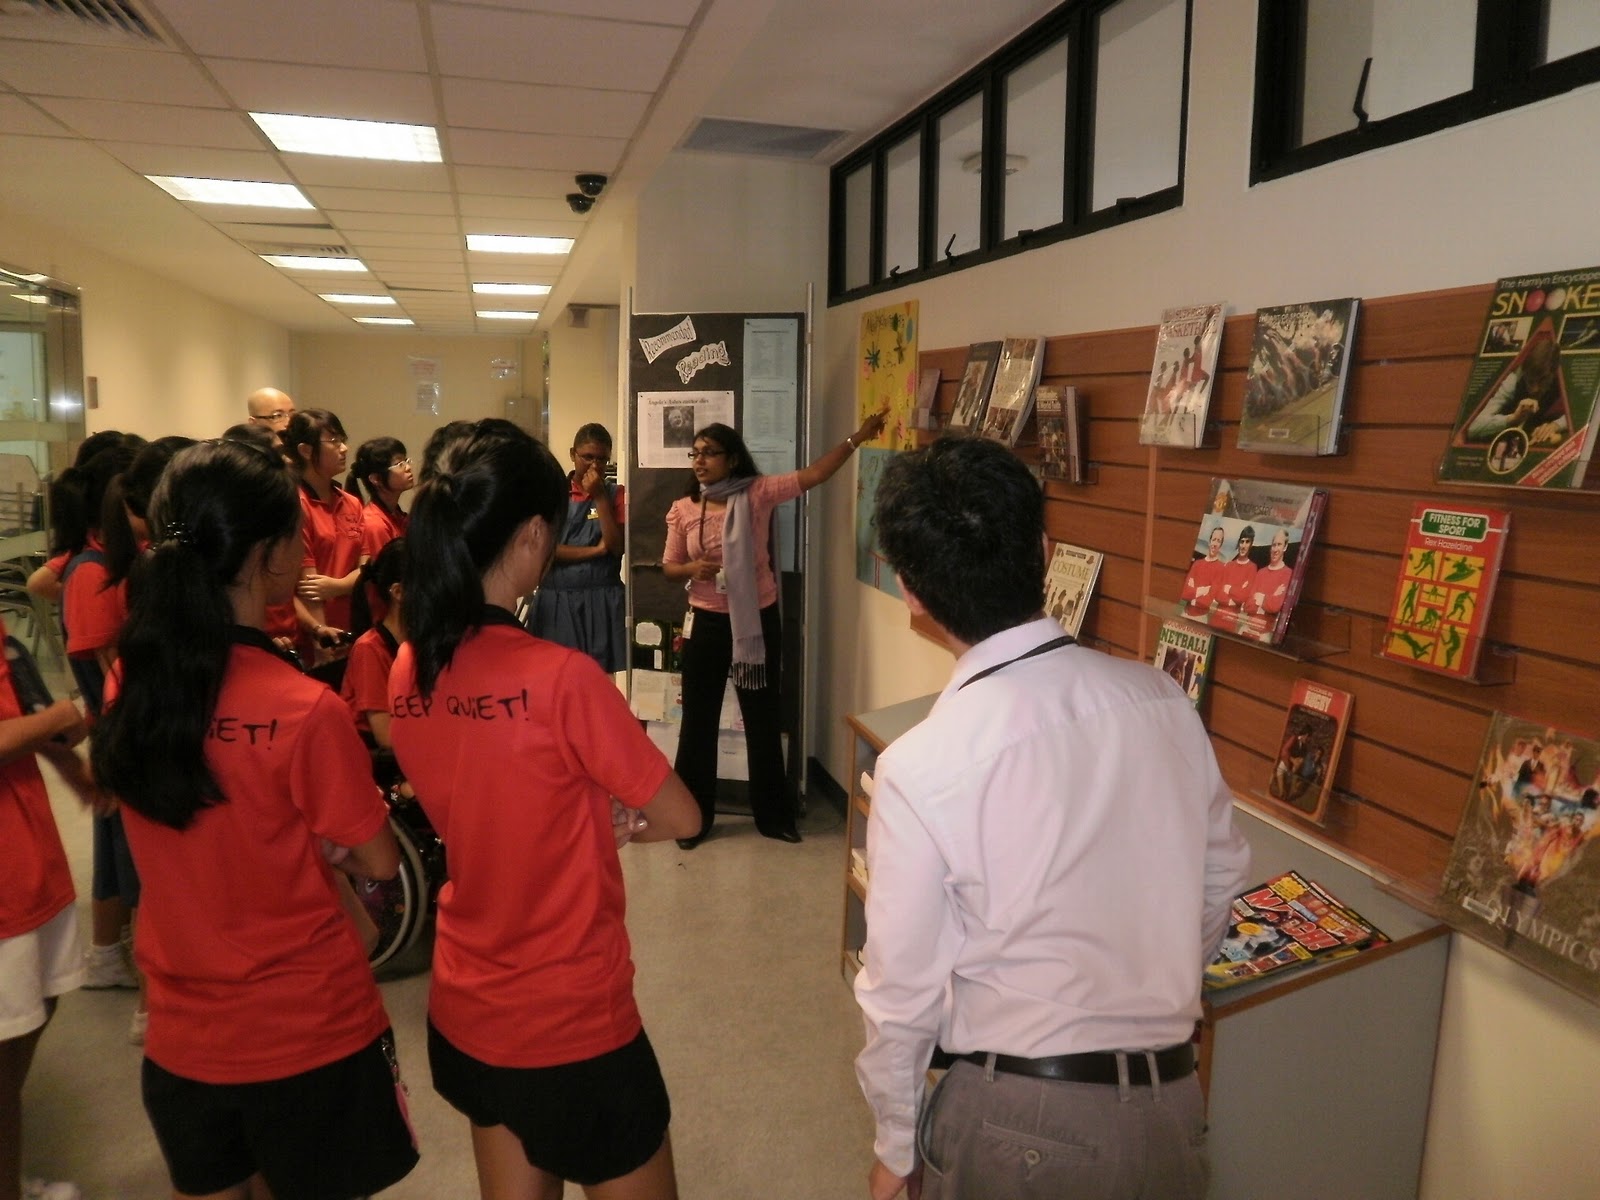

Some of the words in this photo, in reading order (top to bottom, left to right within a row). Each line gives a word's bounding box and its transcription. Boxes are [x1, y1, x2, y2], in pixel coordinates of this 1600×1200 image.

[678, 345, 729, 383] Reading
[1428, 513, 1461, 527] FITNESS
[1462, 516, 1481, 529] FOR
[1438, 525, 1467, 537] SPORT
[1424, 537, 1438, 547] Rex
[1438, 539, 1474, 553] Hazeldine
[1052, 560, 1089, 581] COSTUME
[1160, 628, 1207, 656] NETBALL
[390, 694, 434, 719] EEP
